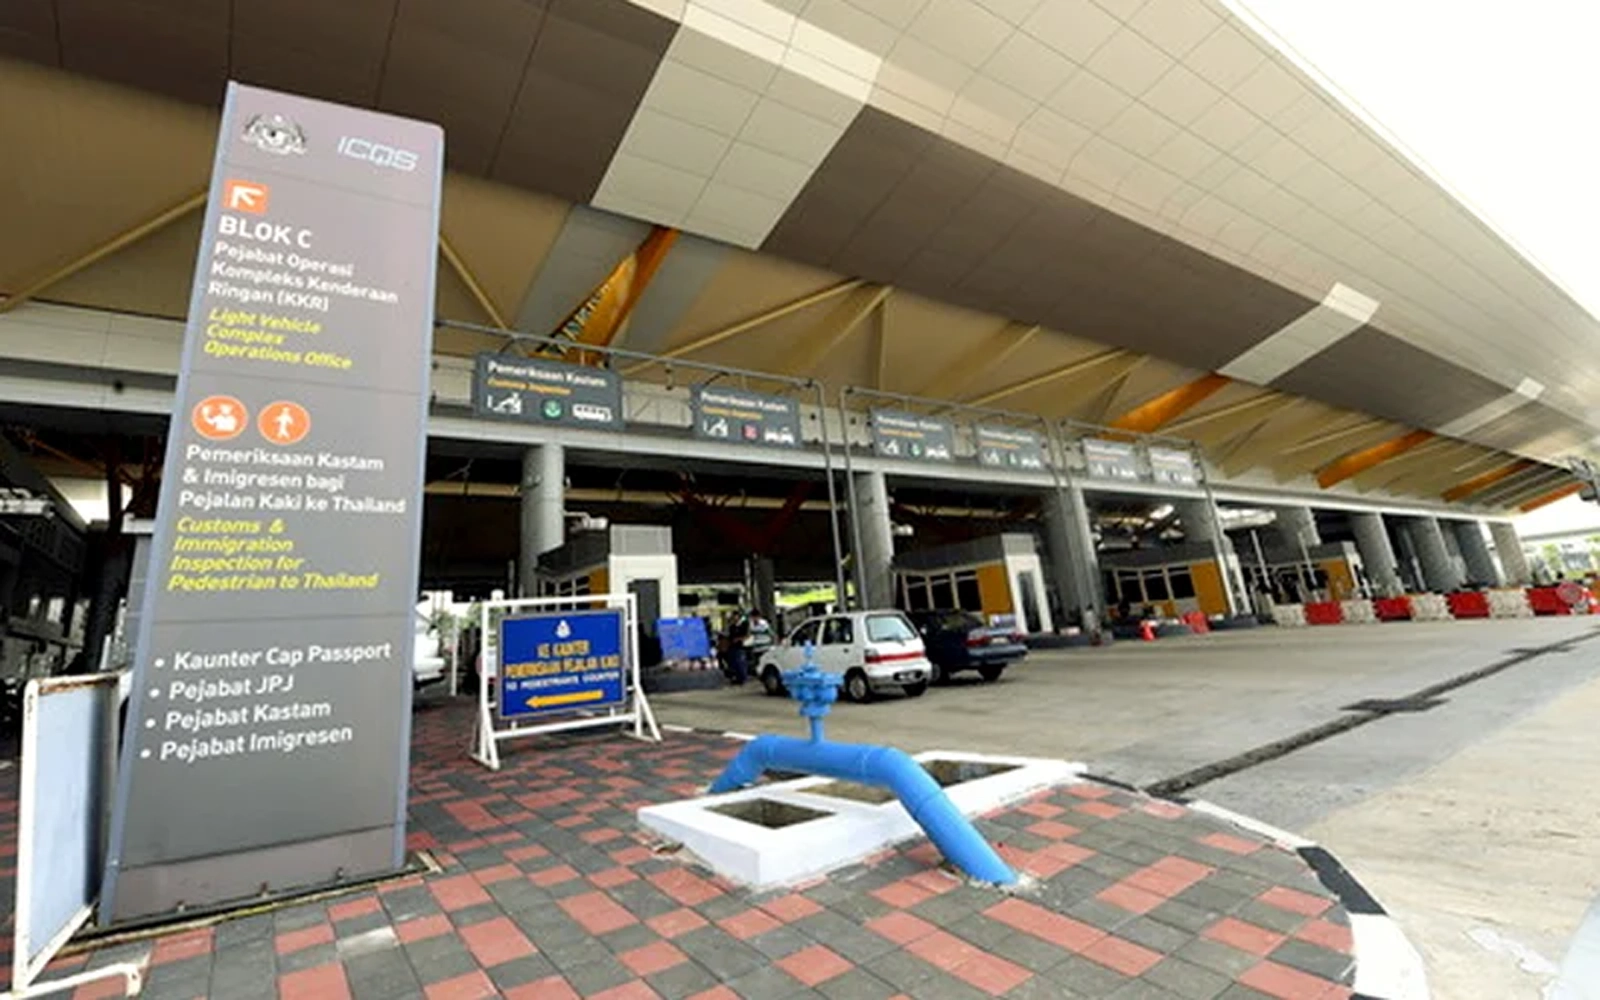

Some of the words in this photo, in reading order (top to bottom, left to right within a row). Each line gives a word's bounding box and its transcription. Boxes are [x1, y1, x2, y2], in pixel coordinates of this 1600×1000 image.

[337, 135, 420, 172] ICQS
[218, 214, 291, 245] BLOK
[297, 229, 313, 248] C
[214, 241, 284, 266] Pejabat
[286, 252, 354, 277] Operasi
[211, 261, 303, 288] Kompleks
[306, 275, 399, 303] Kenderaan
[207, 281, 274, 305] Ringan
[277, 290, 329, 312] (KKR)
[205, 322, 287, 347] Complex
[208, 308, 256, 328] Light
[259, 313, 322, 335] Vehicle
[204, 339, 301, 364] Operations
[303, 350, 353, 371] Office
[488, 360, 565, 381] Pemeriksaan
[186, 444, 314, 468] Pemeriksaan
[317, 452, 385, 471] Kastam
[182, 468, 199, 484] &
[203, 469, 303, 489] Imigresen
[306, 474, 345, 493] bagi
[179, 490, 255, 512] Pejalan
[258, 494, 302, 511] Kaki
[305, 494, 329, 511] ke
[331, 496, 407, 514] Thailand
[176, 516, 261, 534] Customs
[268, 518, 285, 534] &
[173, 535, 294, 555] Immigration
[170, 554, 273, 573] Inspection
[276, 555, 304, 571] for
[167, 573, 276, 592] Pedestrian
[279, 574, 299, 589] to
[302, 572, 379, 589] Thailand
[173, 650, 263, 671] Kaunter
[265, 647, 303, 668] Cap
[307, 642, 392, 664] Passport
[168, 678, 251, 702] Pejabat
[256, 674, 295, 695] JPJ
[164, 708, 249, 732] Pejabat
[253, 702, 332, 723] Kastam
[159, 737, 245, 763] Pejabat
[250, 726, 353, 752] Imigresen
